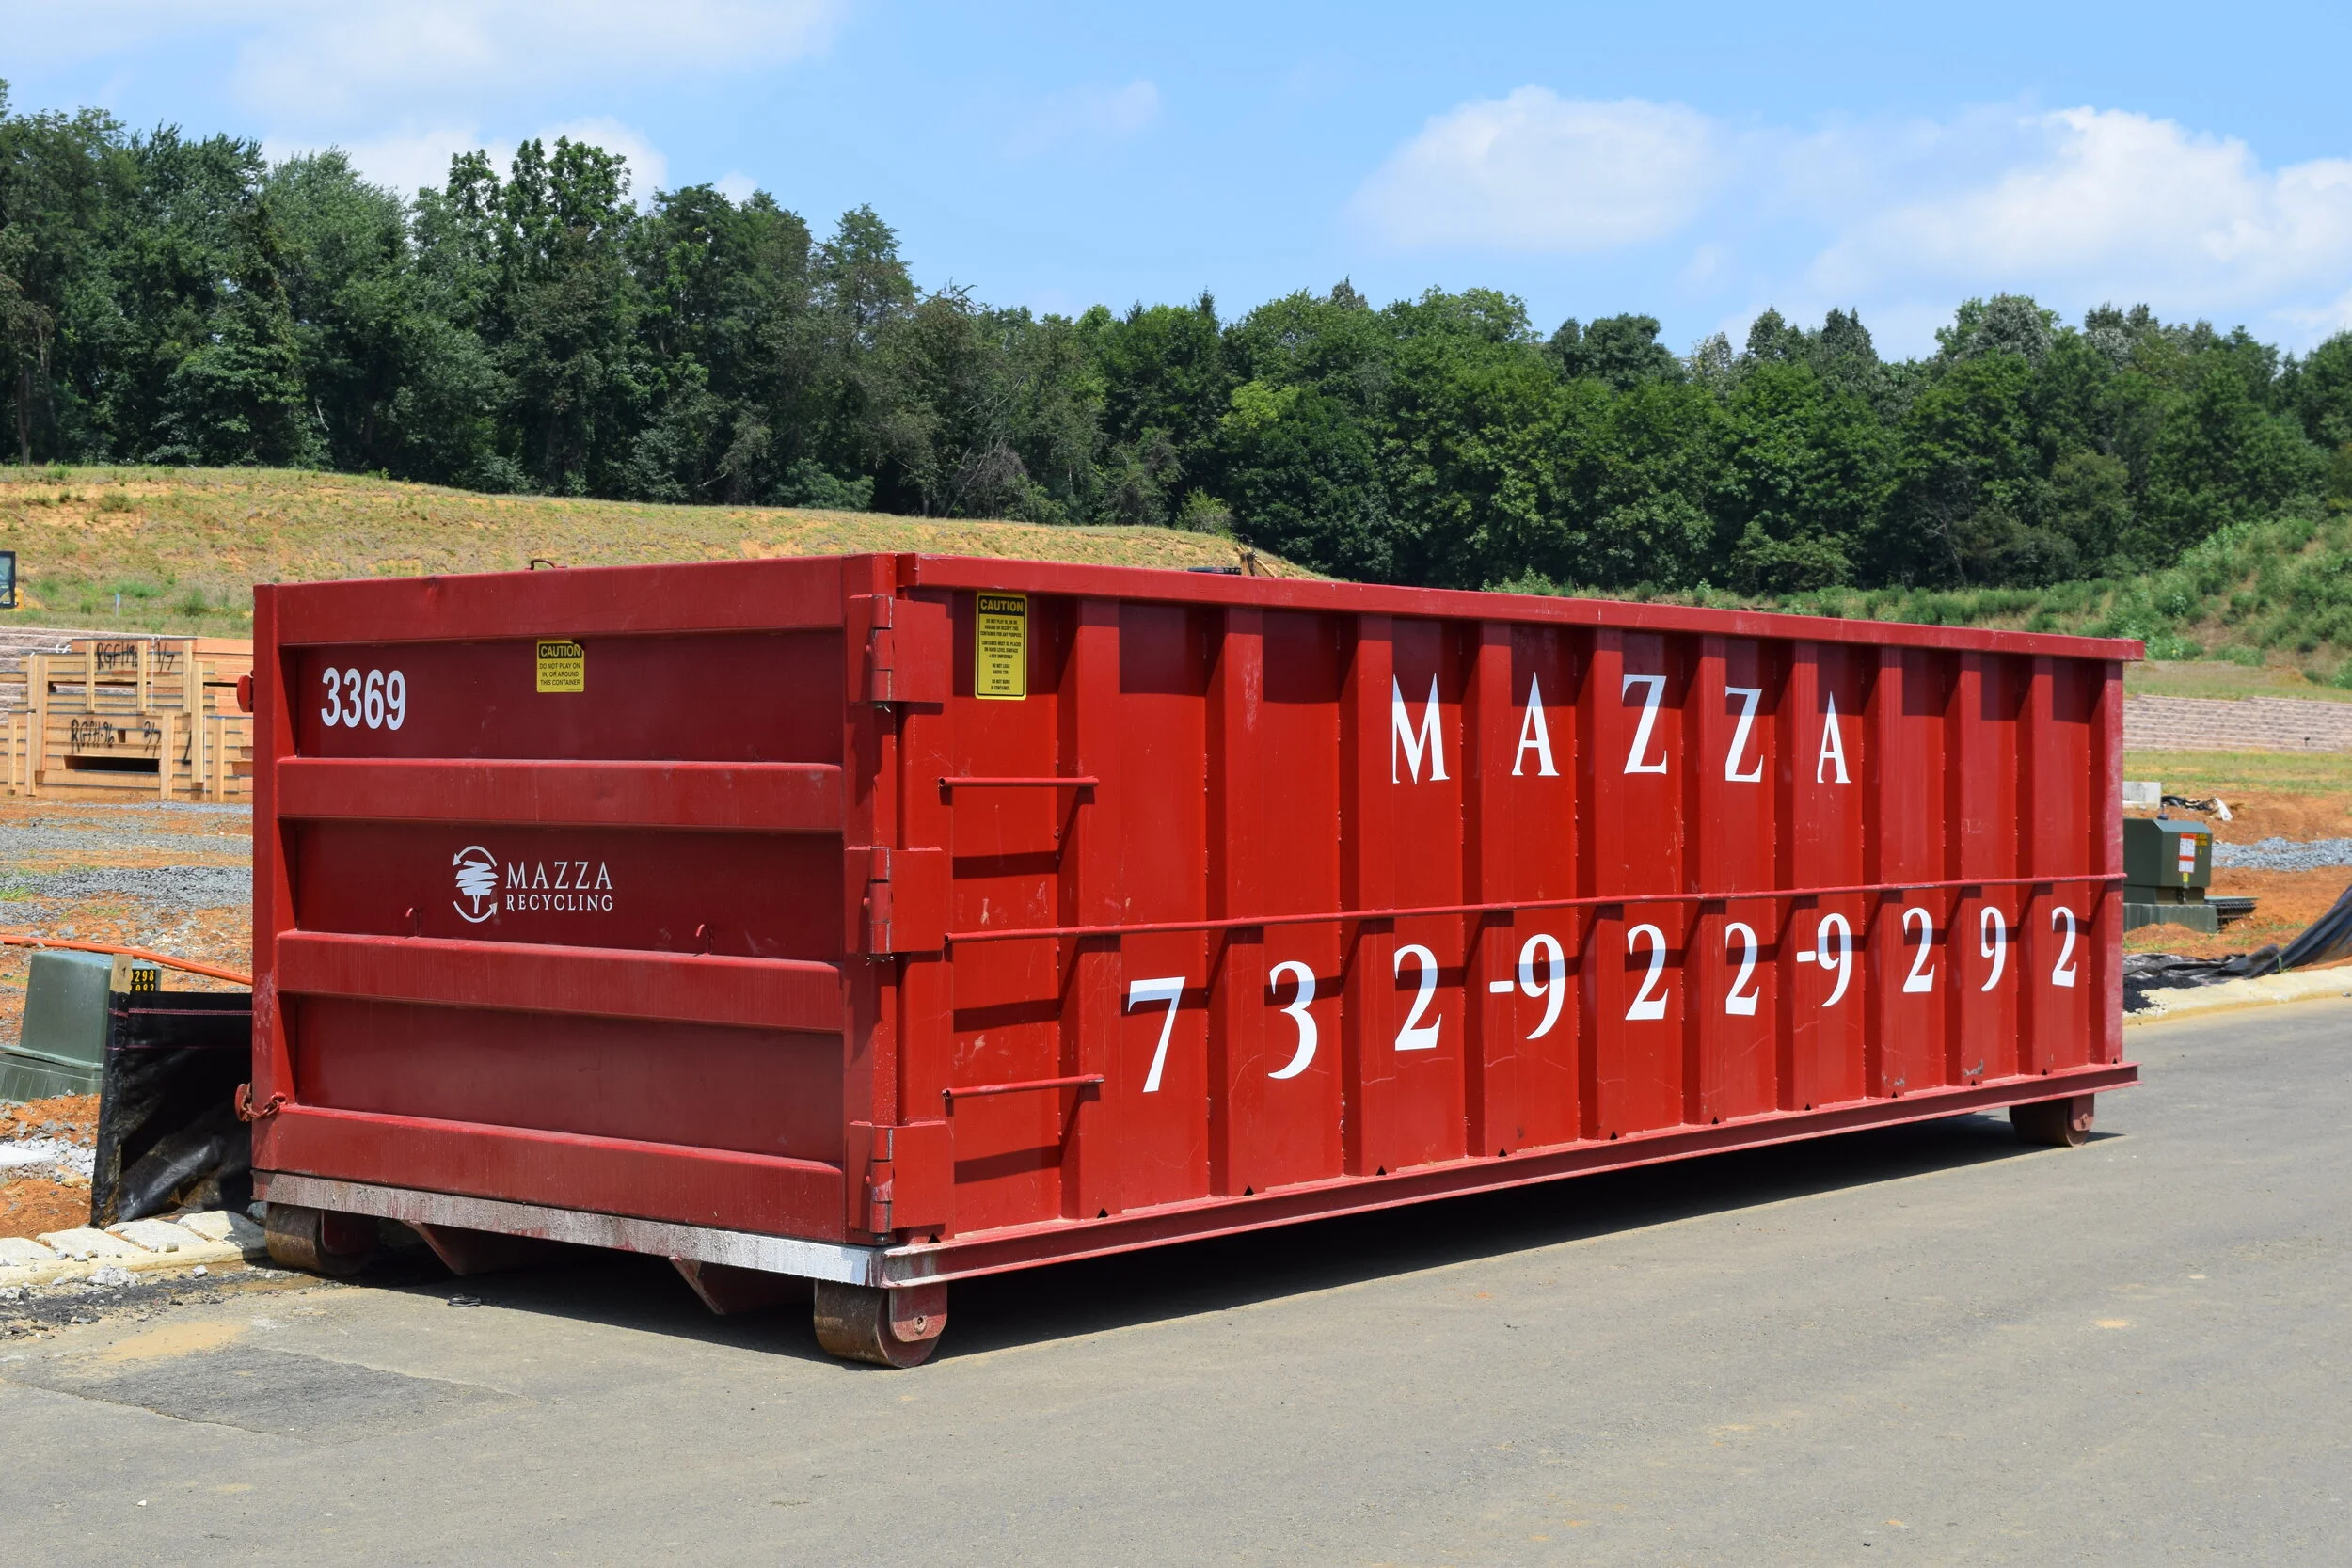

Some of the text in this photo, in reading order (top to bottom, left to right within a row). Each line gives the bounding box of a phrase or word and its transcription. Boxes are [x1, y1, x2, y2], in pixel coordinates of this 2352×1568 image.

[980, 598, 1024, 612] CAUTION
[540, 645, 580, 657] CAUTION
[321, 667, 406, 731] 3369
[1391, 672, 1851, 785] MAZZA
[505, 861, 613, 890] MAZZA
[505, 894, 613, 912] RECYCLING
